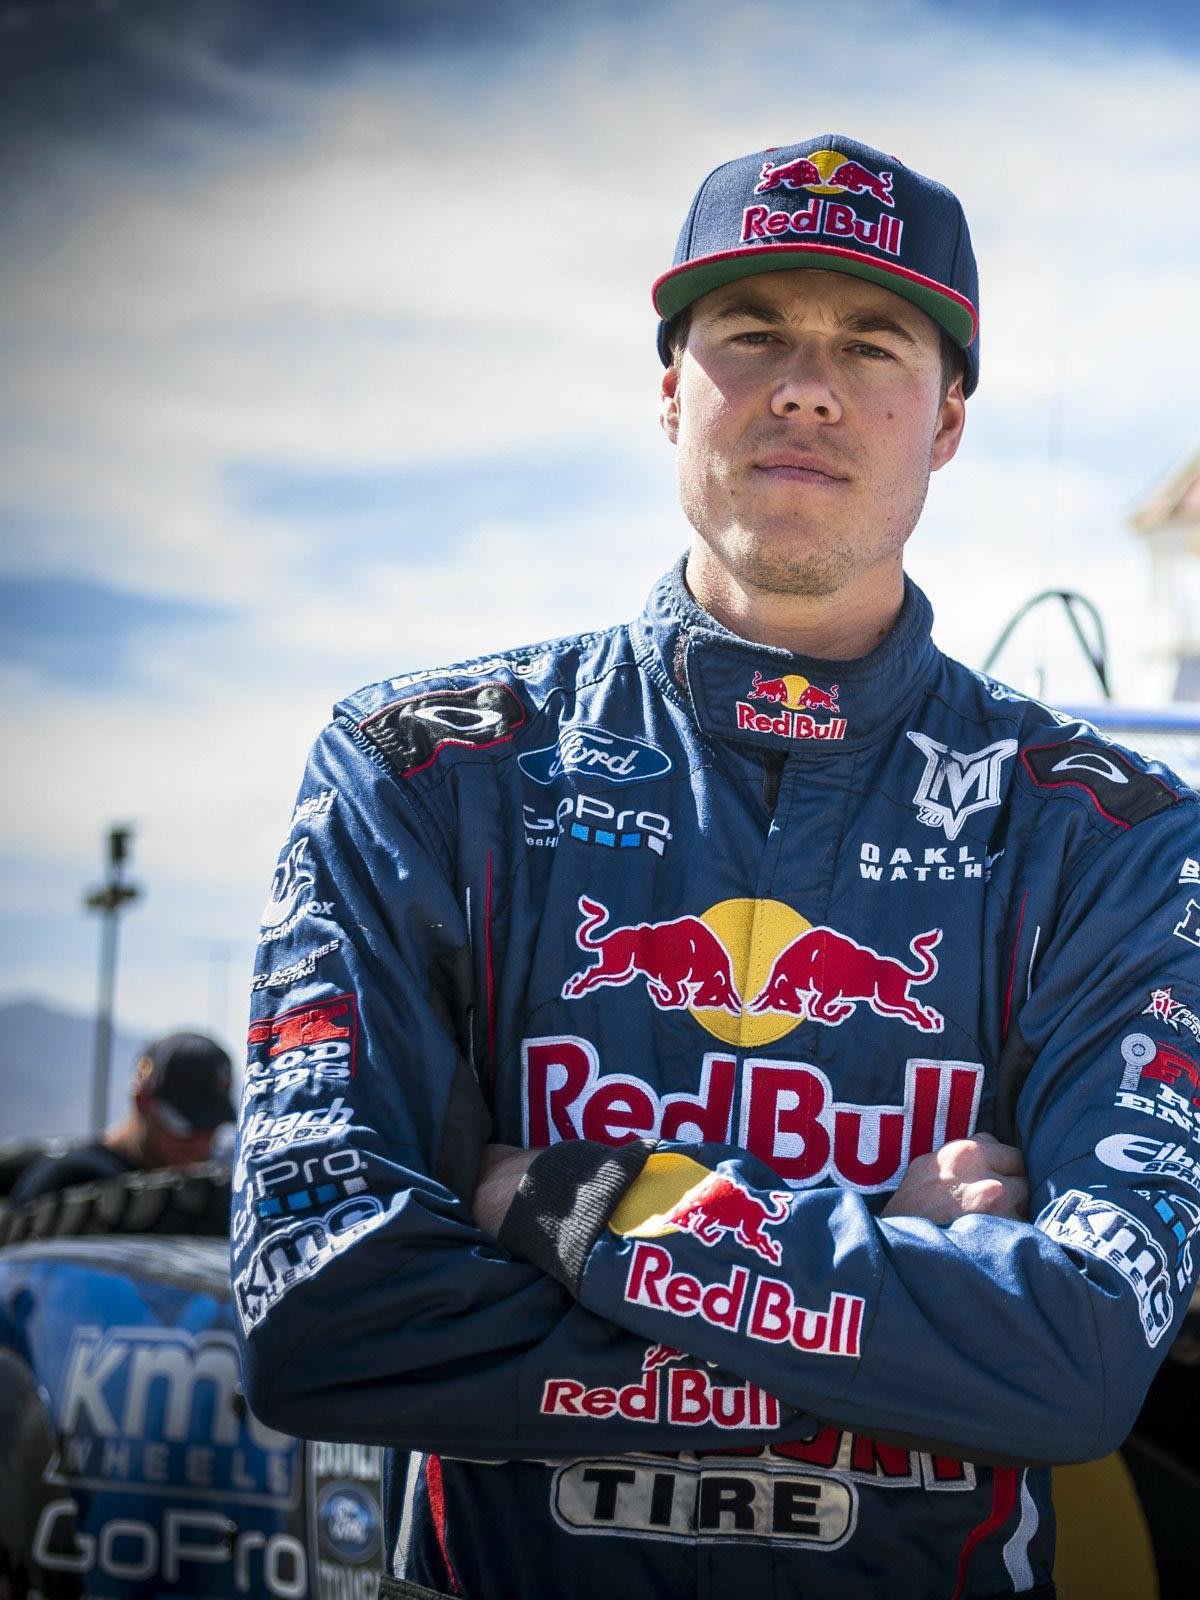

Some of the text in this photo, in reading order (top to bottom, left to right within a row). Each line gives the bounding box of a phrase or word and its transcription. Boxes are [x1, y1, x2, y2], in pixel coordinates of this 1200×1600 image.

[741, 199, 904, 256] Red Bull
[736, 702, 848, 740] Red Bull
[548, 730, 640, 777] Ford
[522, 1035, 986, 1195] Red Bull
[625, 1241, 866, 1357] Red Bull
[541, 1366, 780, 1429] Red Bull
[64, 1438, 292, 1495] WHEELS
[583, 1467, 821, 1537] TIRE
[32, 1498, 306, 1598] GoPro
